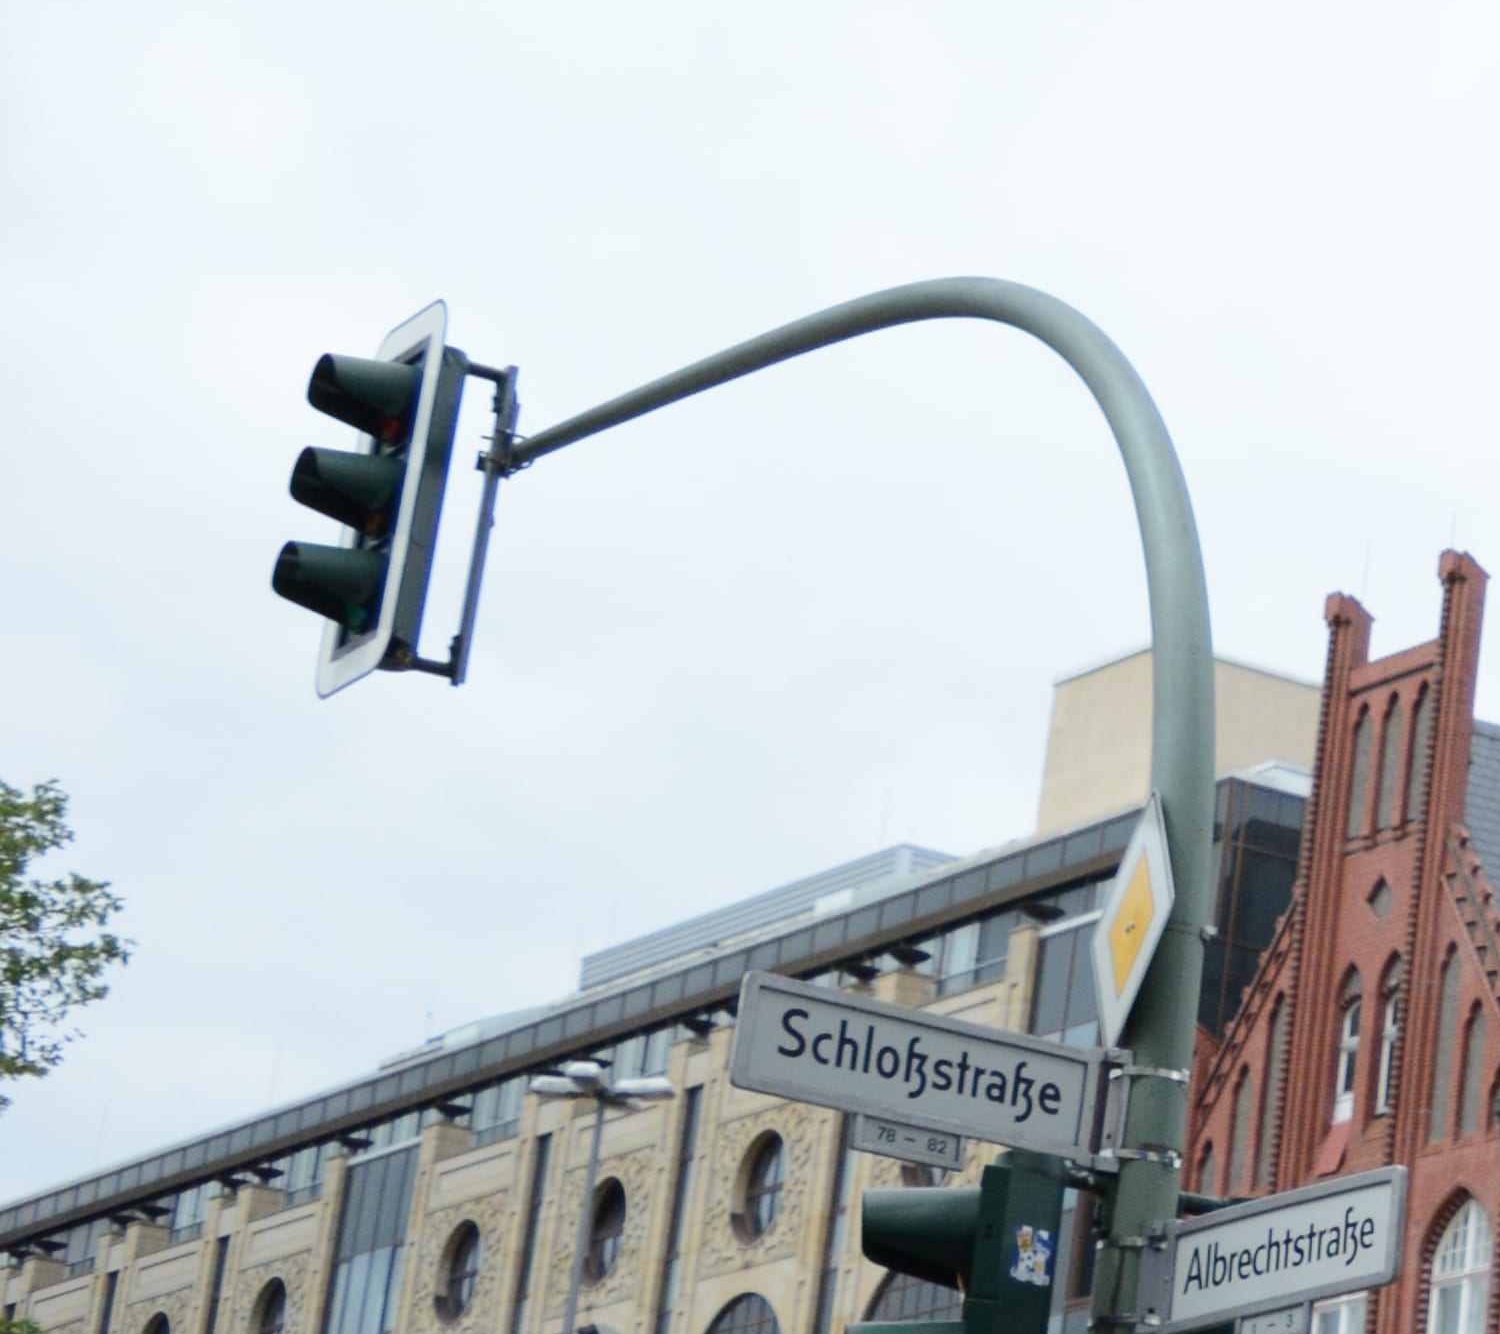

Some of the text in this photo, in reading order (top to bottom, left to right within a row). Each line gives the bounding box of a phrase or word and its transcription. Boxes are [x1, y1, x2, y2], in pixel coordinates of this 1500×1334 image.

[778, 1008, 1062, 1122] Schloßstraße
[876, 1126, 896, 1143] 78
[927, 1138, 949, 1154] 82
[1183, 1206, 1375, 1295] Albrechtstraße
[1285, 1314, 1294, 1328] 3
